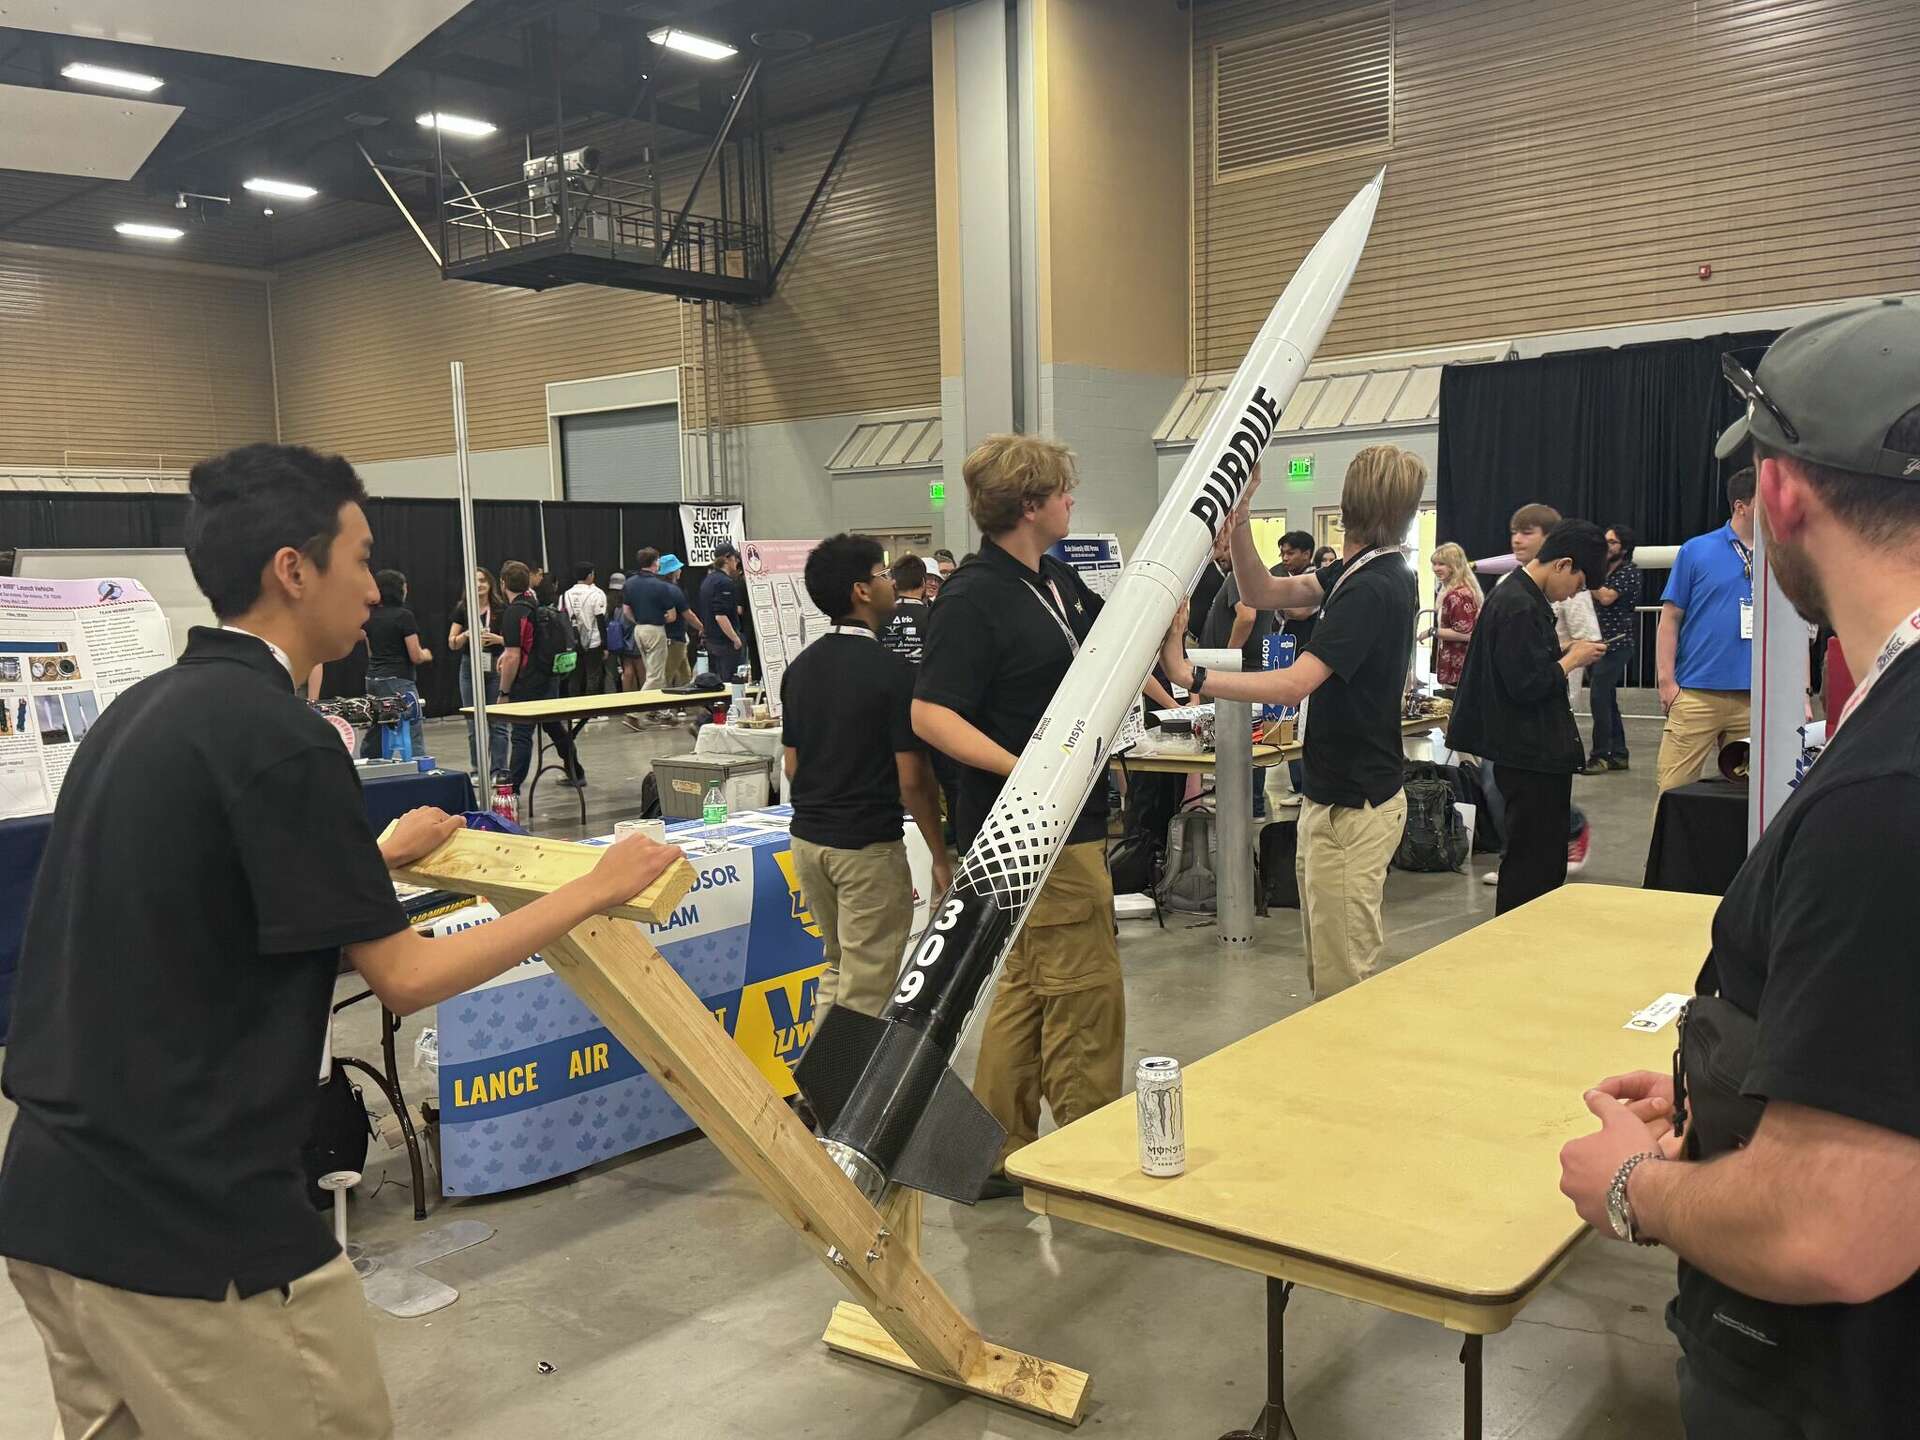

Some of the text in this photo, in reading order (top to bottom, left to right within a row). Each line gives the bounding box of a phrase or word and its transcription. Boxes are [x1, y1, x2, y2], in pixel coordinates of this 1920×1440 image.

[1190, 386, 1282, 540] PURDUE
[695, 507, 729, 520] FLIGHT
[693, 521, 730, 535] SAFETY
[690, 549, 715, 562] CHEC
[1262, 639, 1270, 667] #400
[1060, 719, 1086, 757] Ansys
[688, 865, 741, 893] DSOR
[894, 899, 965, 1004] 309
[454, 1042, 610, 1108] LANCE AIR
